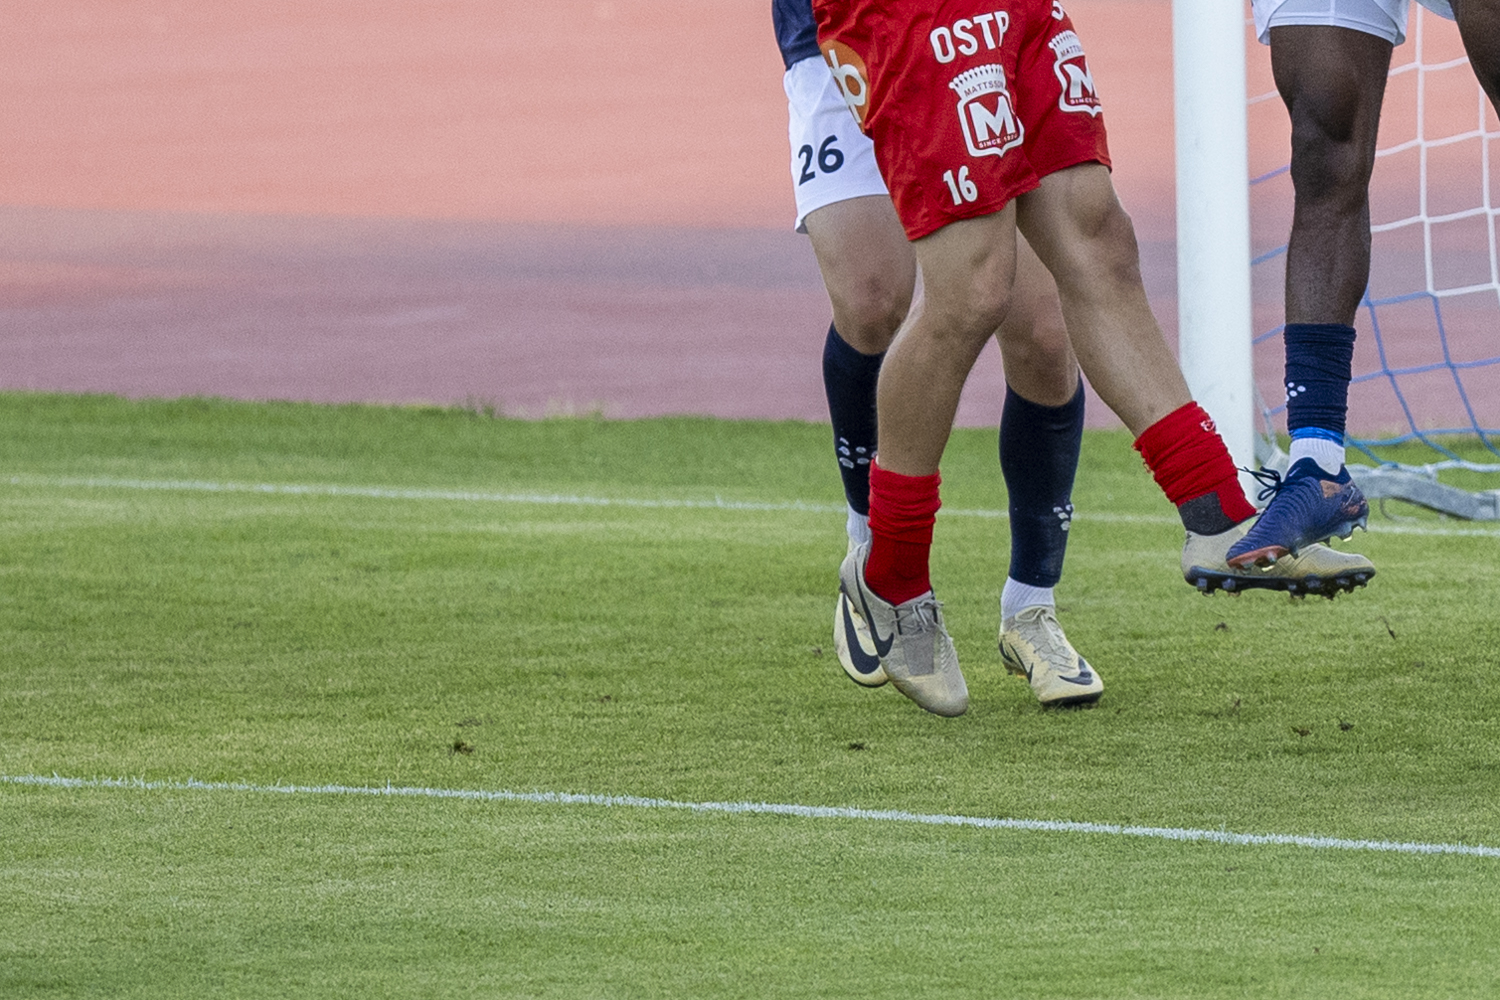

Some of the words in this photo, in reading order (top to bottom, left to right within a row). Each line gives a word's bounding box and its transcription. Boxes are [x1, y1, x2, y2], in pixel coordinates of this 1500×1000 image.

[929, 10, 1010, 64] OSTP
[798, 135, 845, 187] 26
[942, 165, 978, 206] 16
